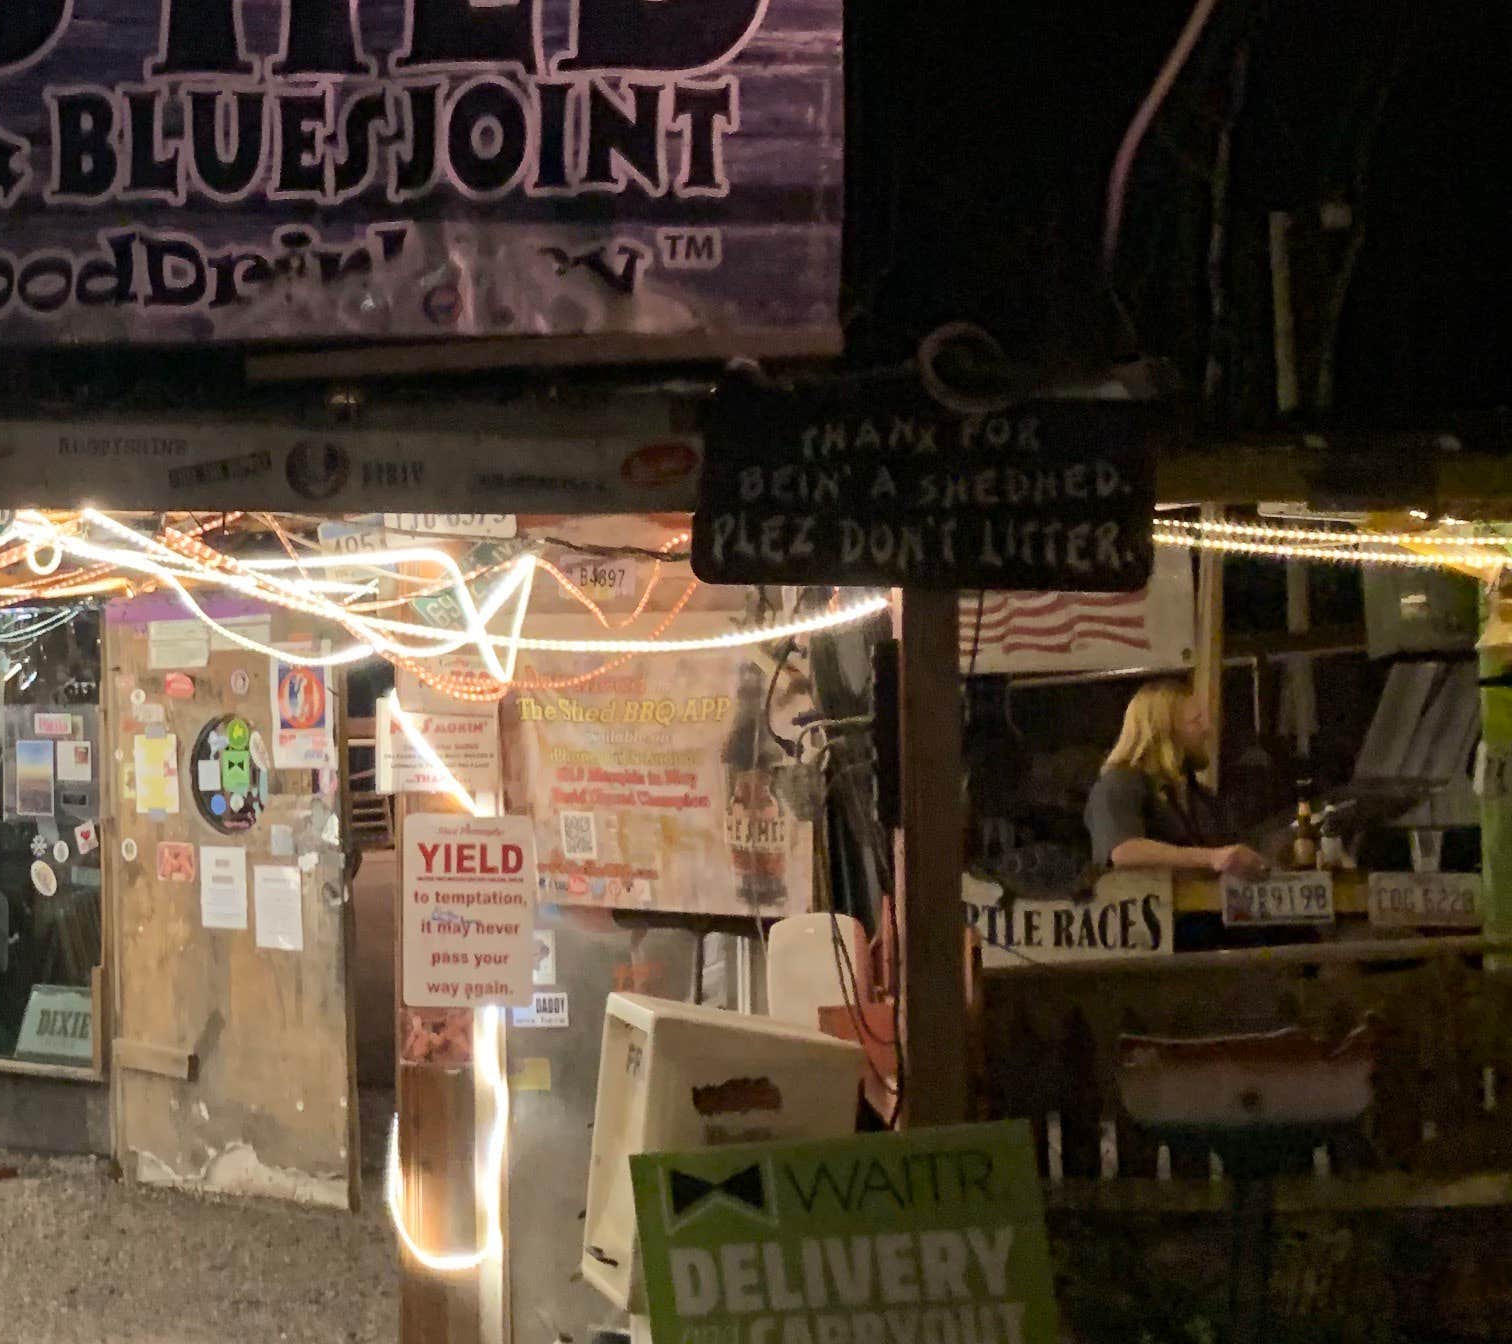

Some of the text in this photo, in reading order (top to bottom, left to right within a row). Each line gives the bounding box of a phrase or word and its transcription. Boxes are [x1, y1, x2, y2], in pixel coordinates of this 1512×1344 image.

[960, 416, 1039, 451] FOR
[872, 465, 898, 497] A
[711, 514, 817, 563] PLEZ
[839, 516, 958, 567] DON'T
[622, 699, 676, 728] BBQ
[417, 842, 524, 875] YIELD
[413, 889, 528, 909] to temptation,
[420, 917, 521, 939] it may never
[1053, 891, 1162, 951] RACES
[431, 950, 511, 970] pass your
[427, 980, 460, 998] way
[785, 1150, 995, 1214] WAITR
[668, 1225, 1017, 1317] DELIVERY
